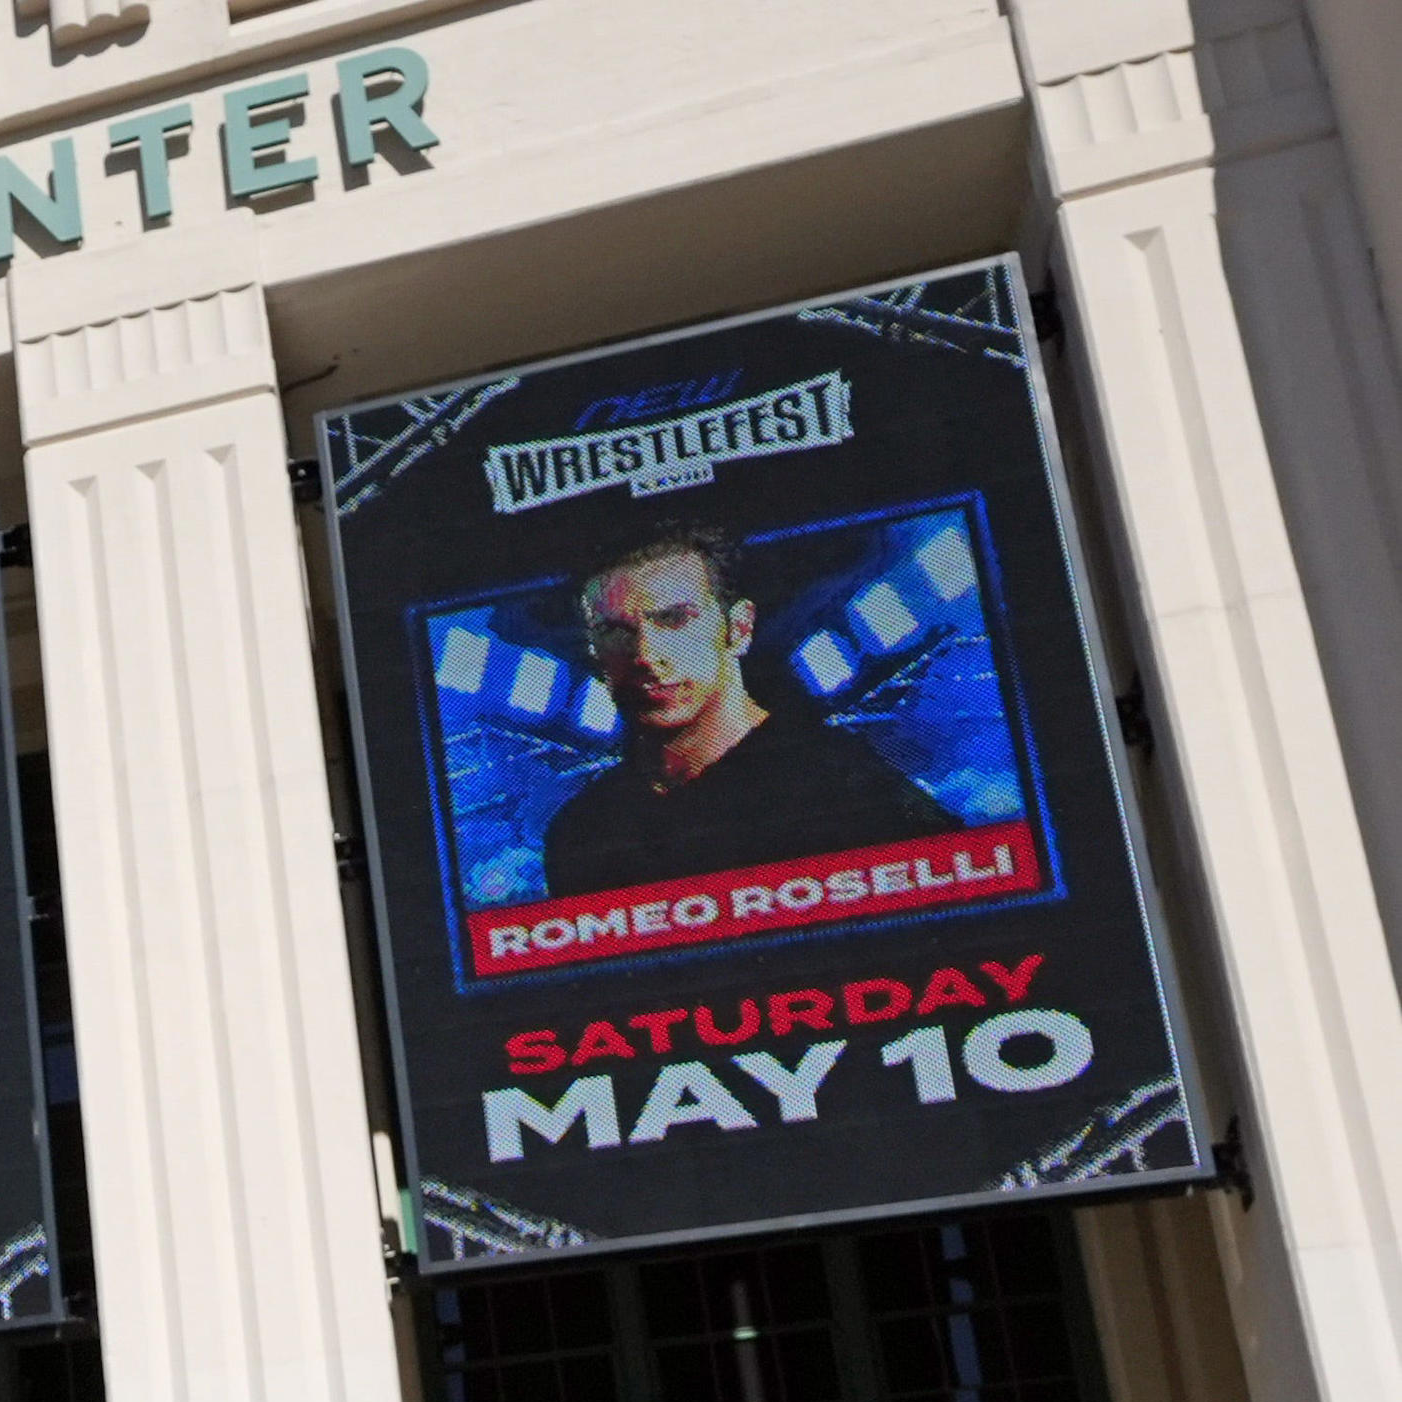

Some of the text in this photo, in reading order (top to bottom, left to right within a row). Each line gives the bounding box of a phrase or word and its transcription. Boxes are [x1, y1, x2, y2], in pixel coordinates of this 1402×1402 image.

[500, 380, 832, 501] WRESTLEFEST
[489, 844, 1014, 957] ROMEO ROSELLI
[505, 953, 1044, 1074] SATURDAY
[482, 1009, 1094, 1163] MAY 10
